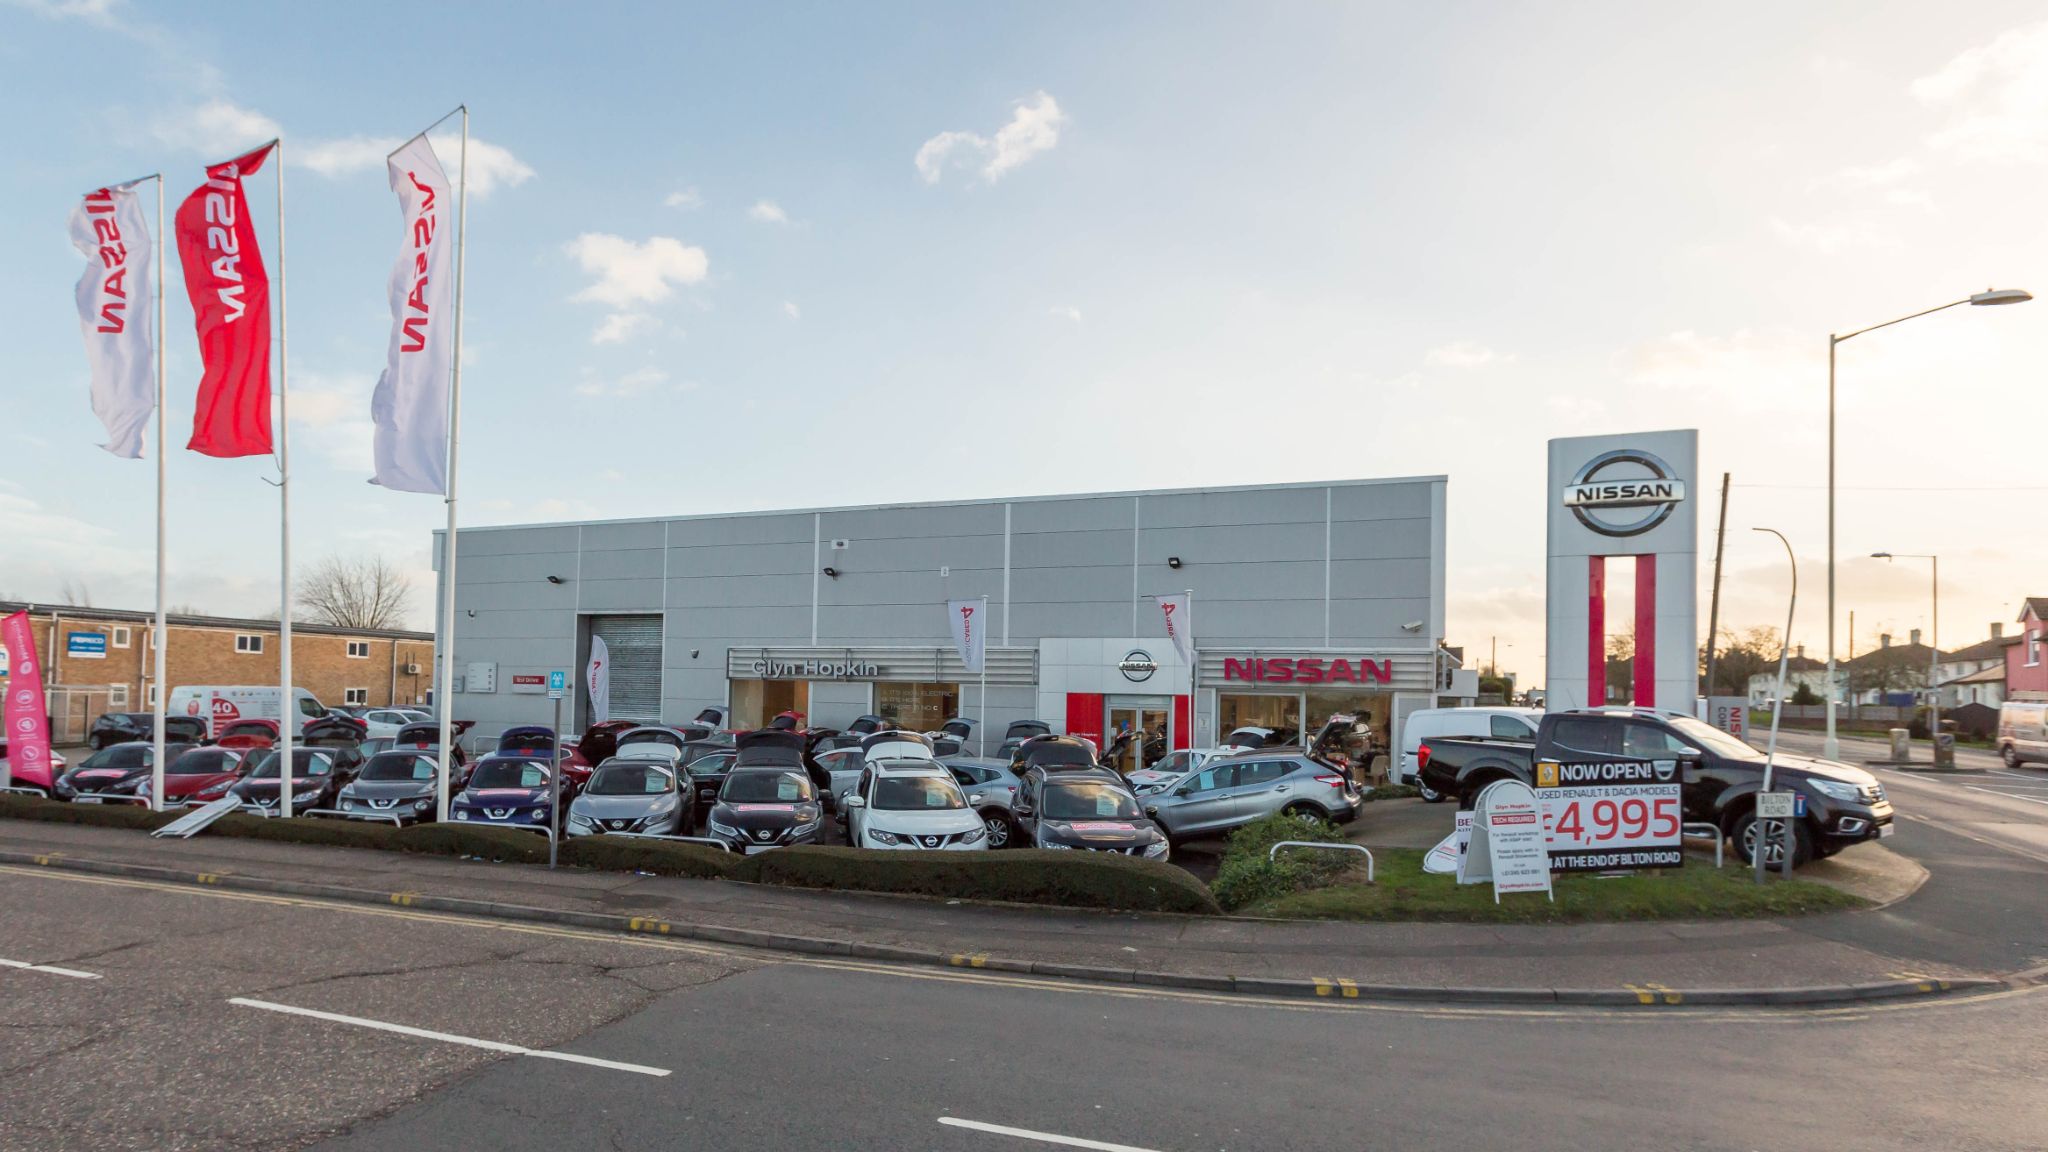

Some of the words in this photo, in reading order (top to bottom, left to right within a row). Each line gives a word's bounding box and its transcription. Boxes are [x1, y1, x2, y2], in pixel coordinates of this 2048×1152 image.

[1576, 483, 1673, 502] NISSAN
[752, 658, 796, 679] Glyn
[803, 659, 878, 679] Hopkin
[1224, 657, 1392, 684] NISSAN
[212, 702, 232, 713] 40
[1560, 764, 1600, 781] NOW
[1602, 762, 1652, 779] OPEN!
[1537, 790, 1561, 800] USED
[1562, 789, 1603, 798] RENAULT
[1604, 788, 1610, 797] &
[1612, 787, 1638, 797] DACIA
[1640, 786, 1678, 796] MODELS
[1761, 795, 1791, 805] BILTON
[1764, 805, 1787, 815] ROAD
[1554, 857, 1567, 868] AT
[1567, 856, 1588, 867] THE
[1588, 855, 1608, 866] END
[1608, 854, 1620, 865] OF
[1620, 853, 1653, 865] BILTON
[1653, 852, 1681, 863] ROAD
